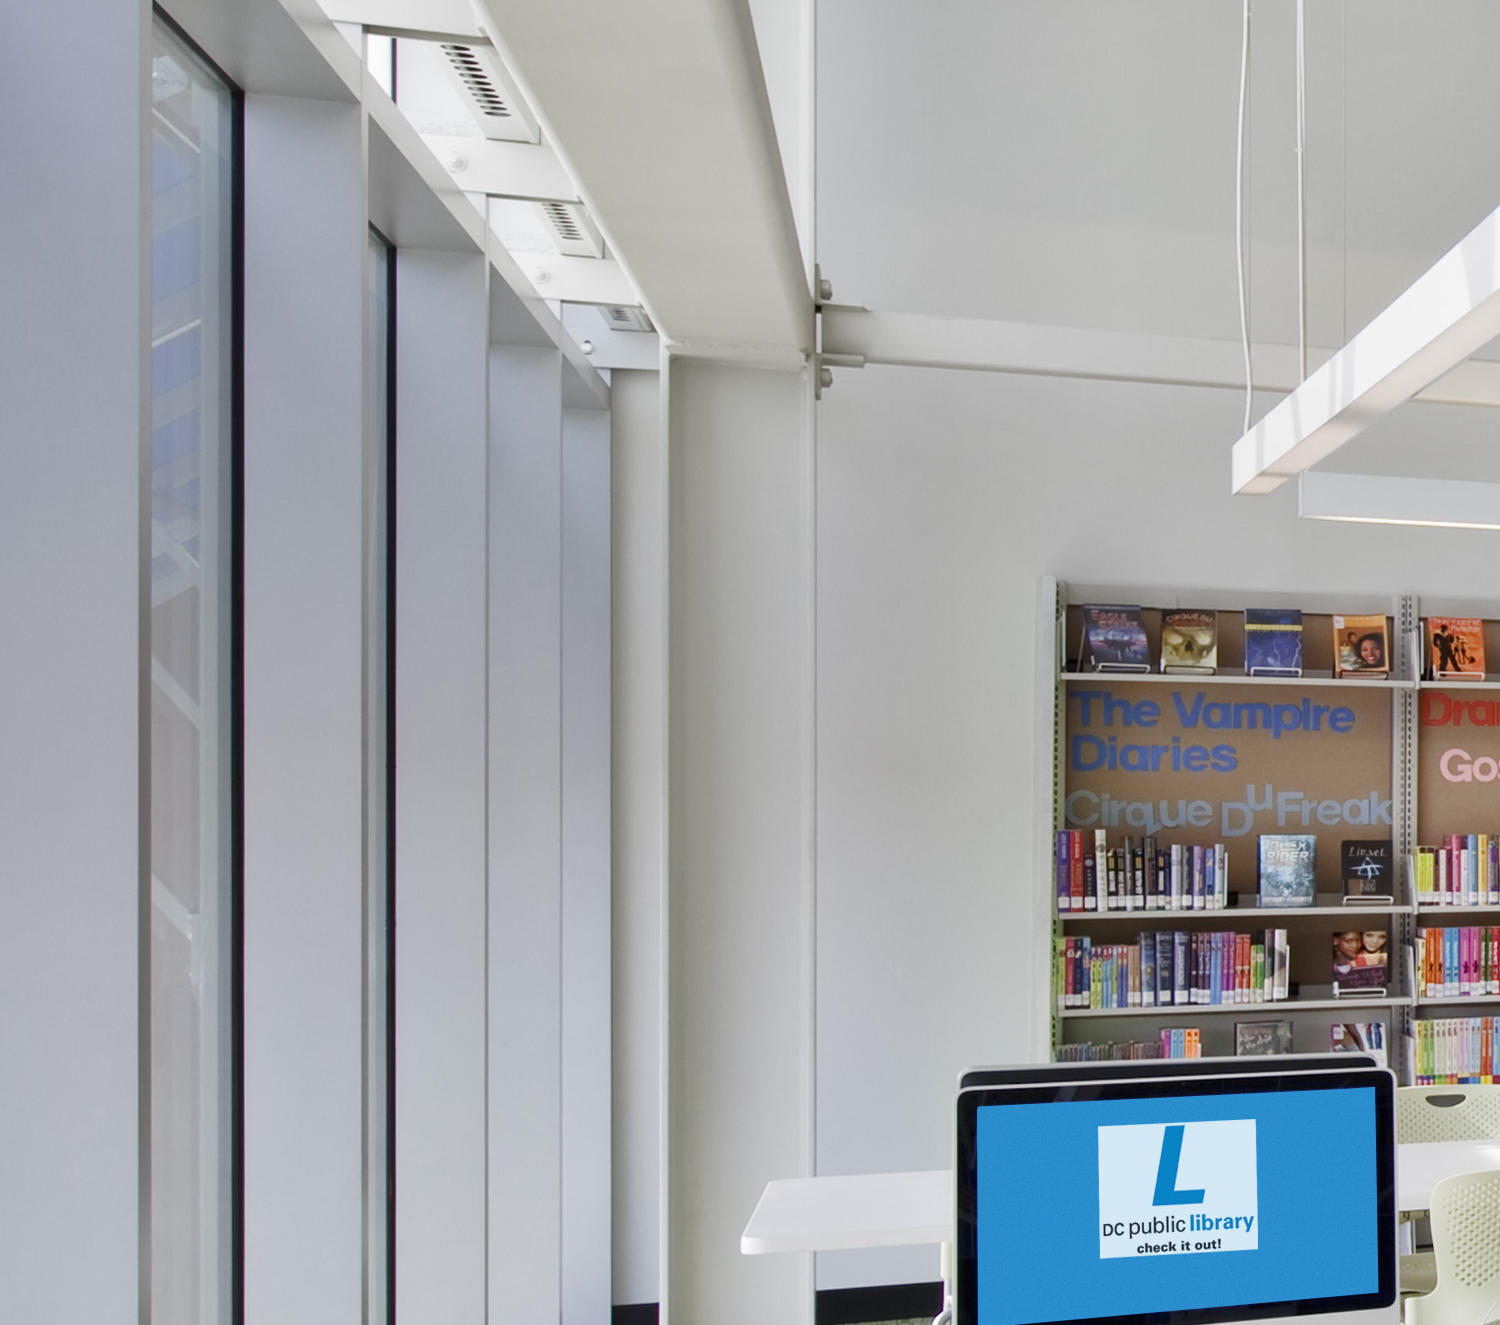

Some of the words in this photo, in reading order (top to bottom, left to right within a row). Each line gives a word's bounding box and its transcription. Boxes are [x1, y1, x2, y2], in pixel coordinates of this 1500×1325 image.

[1071, 690, 1160, 727] The
[1171, 692, 1355, 740] Vampire
[1071, 735, 1238, 773] Diaries
[1065, 789, 1213, 837] Cirque
[1277, 791, 1393, 826] Freak
[1152, 1125, 1205, 1206] L
[1102, 1221, 1124, 1237] DC
[1129, 1215, 1186, 1239] public
[1189, 1213, 1254, 1233] library
[1136, 1240, 1177, 1254] check
[1180, 1240, 1191, 1252] it
[1194, 1238, 1222, 1251] out!
